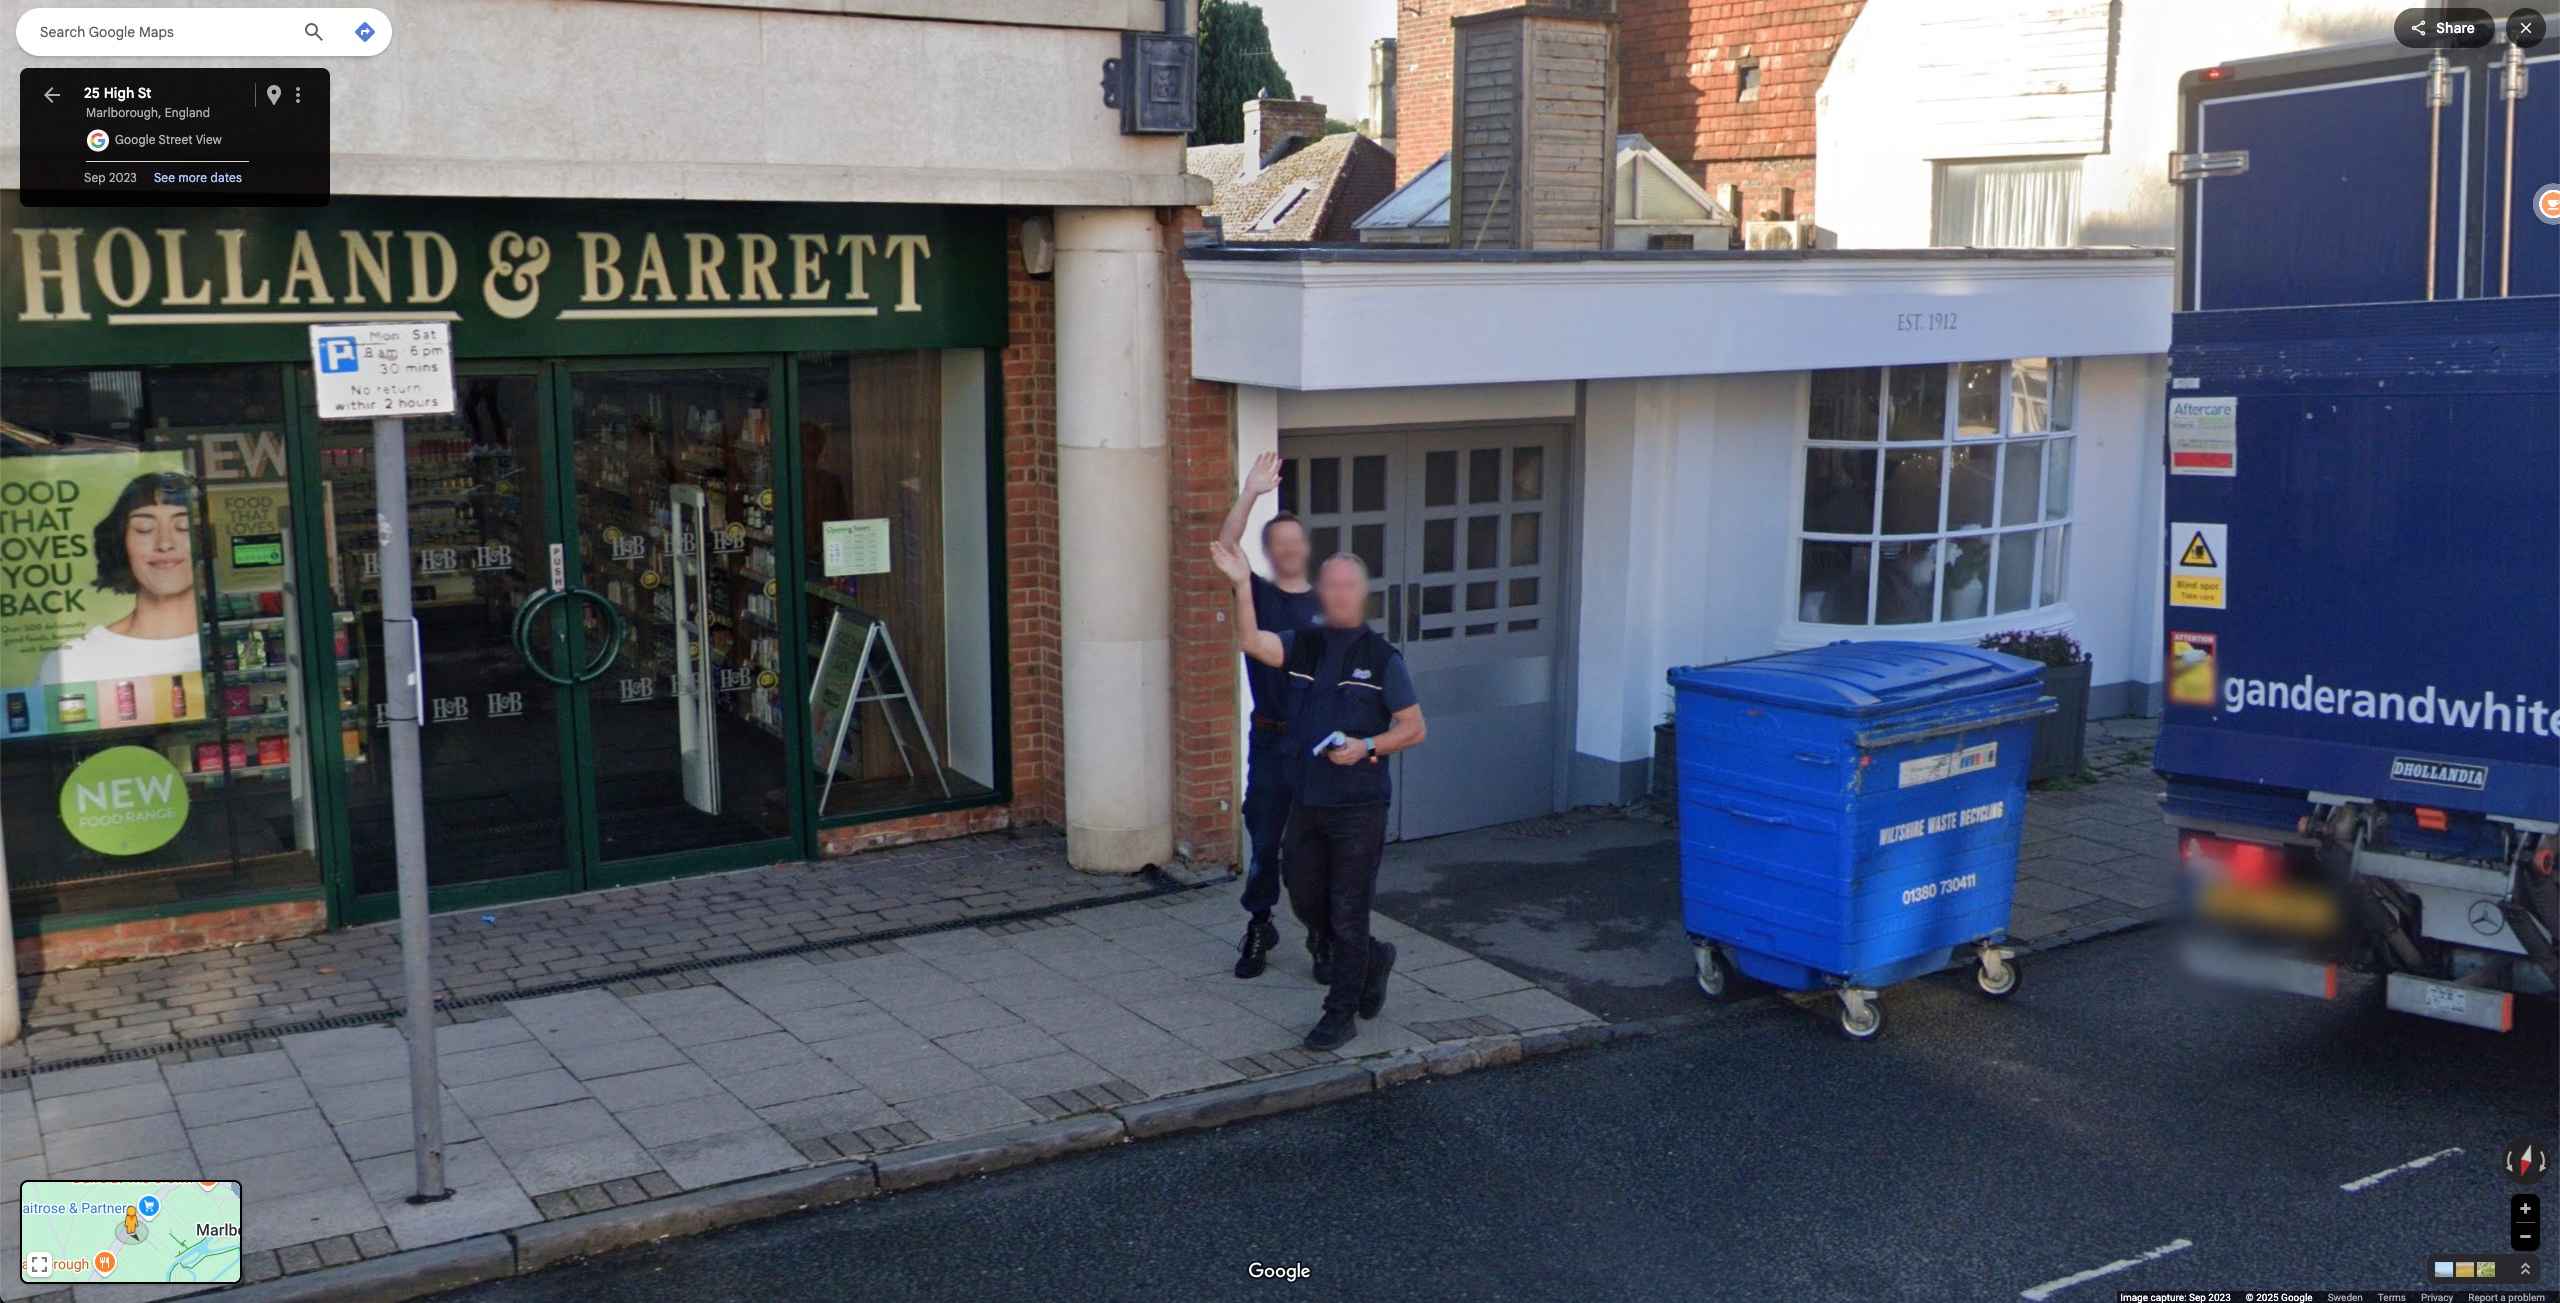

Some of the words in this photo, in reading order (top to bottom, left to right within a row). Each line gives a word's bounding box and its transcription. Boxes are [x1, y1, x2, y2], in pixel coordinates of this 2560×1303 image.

[12, 226, 459, 321] HOLLAND
[483, 229, 552, 319] &
[576, 231, 932, 313] BARRETT
[369, 331, 400, 341] Mon
[412, 328, 437, 341] Sat
[1928, 312, 1958, 331] 1912
[410, 345, 419, 357] 6
[423, 346, 443, 357] pm
[380, 362, 400, 375] 30
[405, 364, 439, 373] mins
[351, 385, 371, 396] No
[377, 383, 421, 395] return
[384, 398, 394, 409] 2
[398, 397, 439, 409] hours
[2174, 403, 2232, 416] Aftercare
[202, 431, 287, 479] EW
[0, 480, 80, 506] OOD
[0, 507, 74, 534] THAT
[0, 534, 88, 561] OVES
[2, 562, 73, 590] YOU
[553, 547, 563, 586] PUSH
[0, 589, 86, 618] BACK
[2392, 761, 2483, 785] DHOLLANDIA
[77, 773, 173, 814] NEW
[79, 814, 124, 828] FOOD
[126, 808, 177, 822] RANGE
[1879, 819, 1925, 847] WILTSHIRE
[1927, 811, 1958, 834] WASTE
[1959, 800, 2004, 828] RECYCLING
[1902, 882, 1937, 905] 01380
[1940, 872, 1977, 895] 730411
